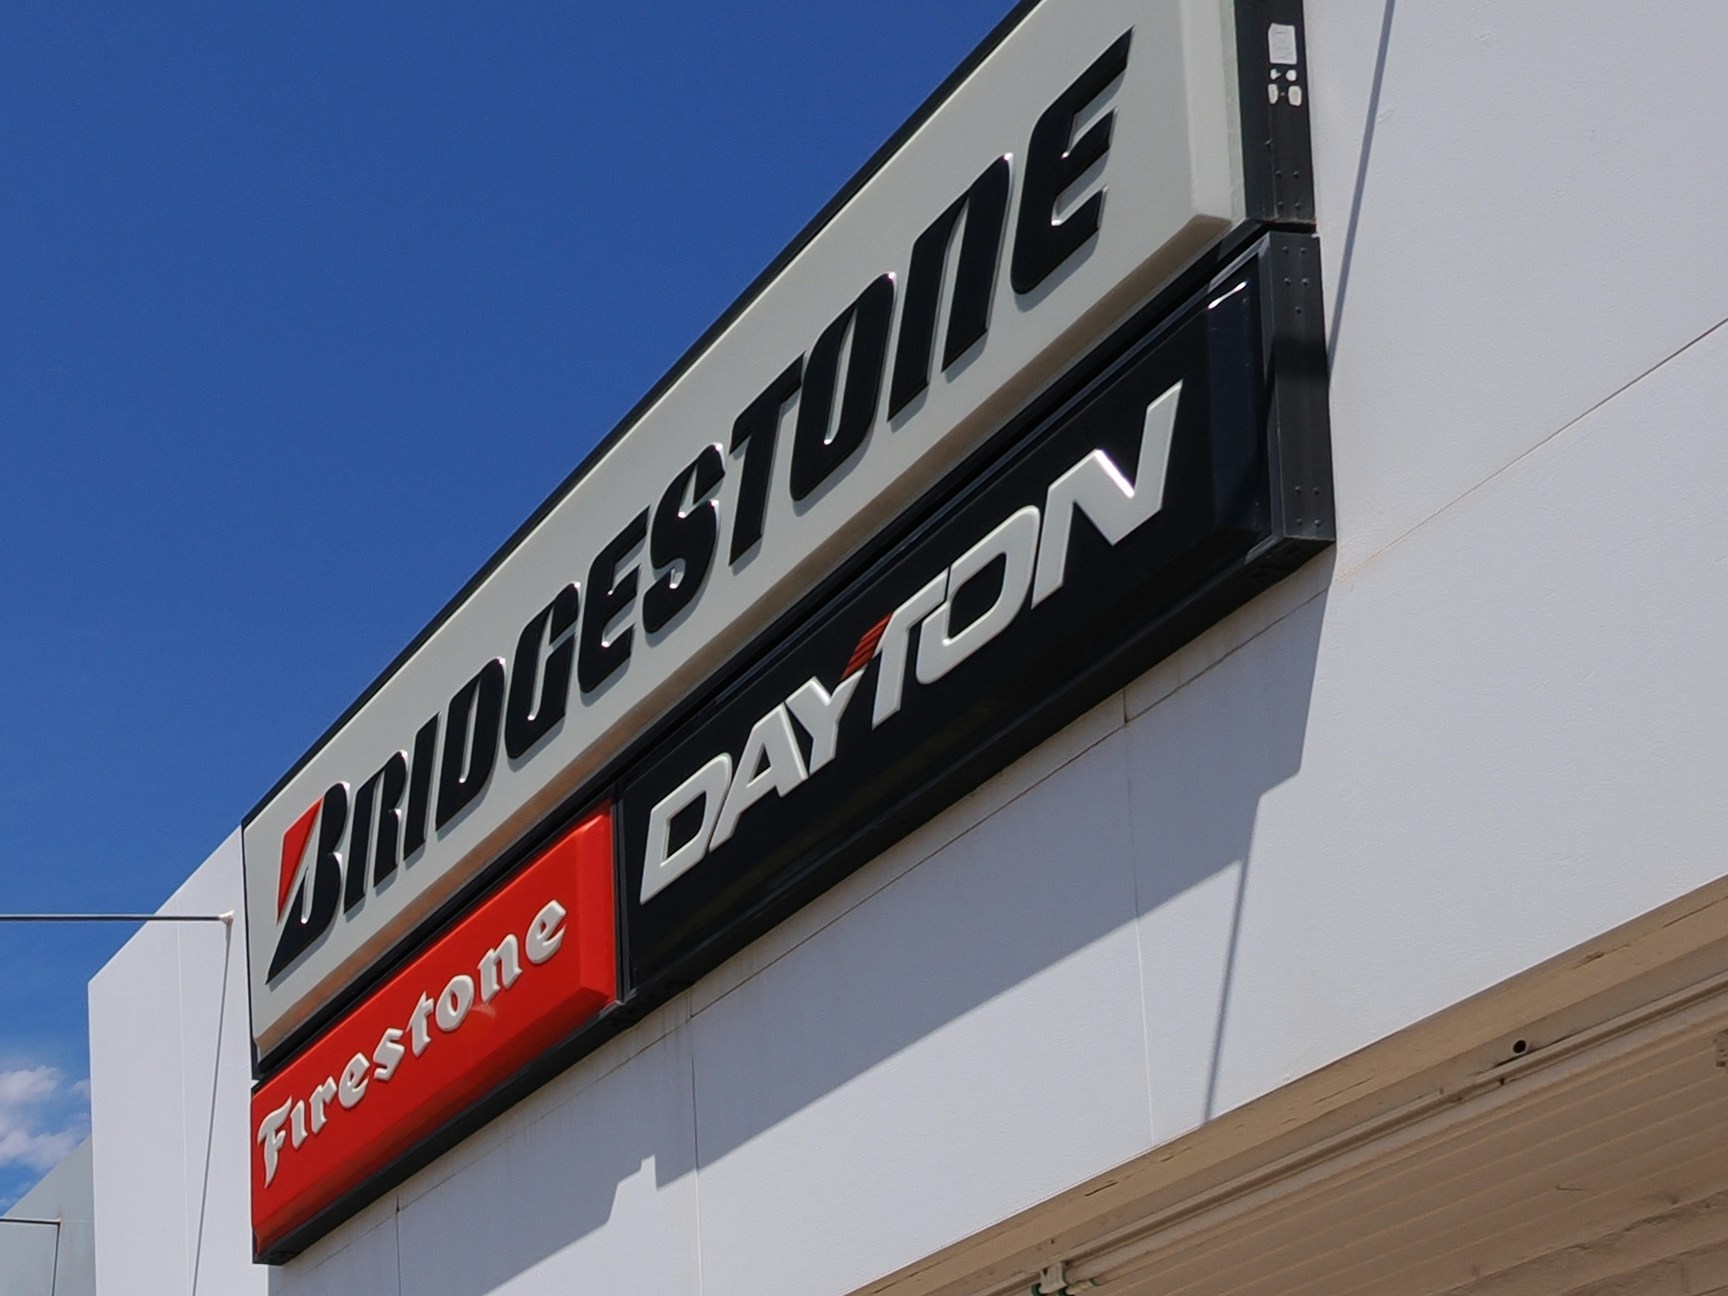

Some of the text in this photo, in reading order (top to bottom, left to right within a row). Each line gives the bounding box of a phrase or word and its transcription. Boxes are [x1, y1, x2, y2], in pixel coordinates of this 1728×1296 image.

[265, 25, 1135, 986] BRIDGESTONE
[639, 379, 1184, 903] DAYTON
[255, 893, 568, 1189] Firestone
